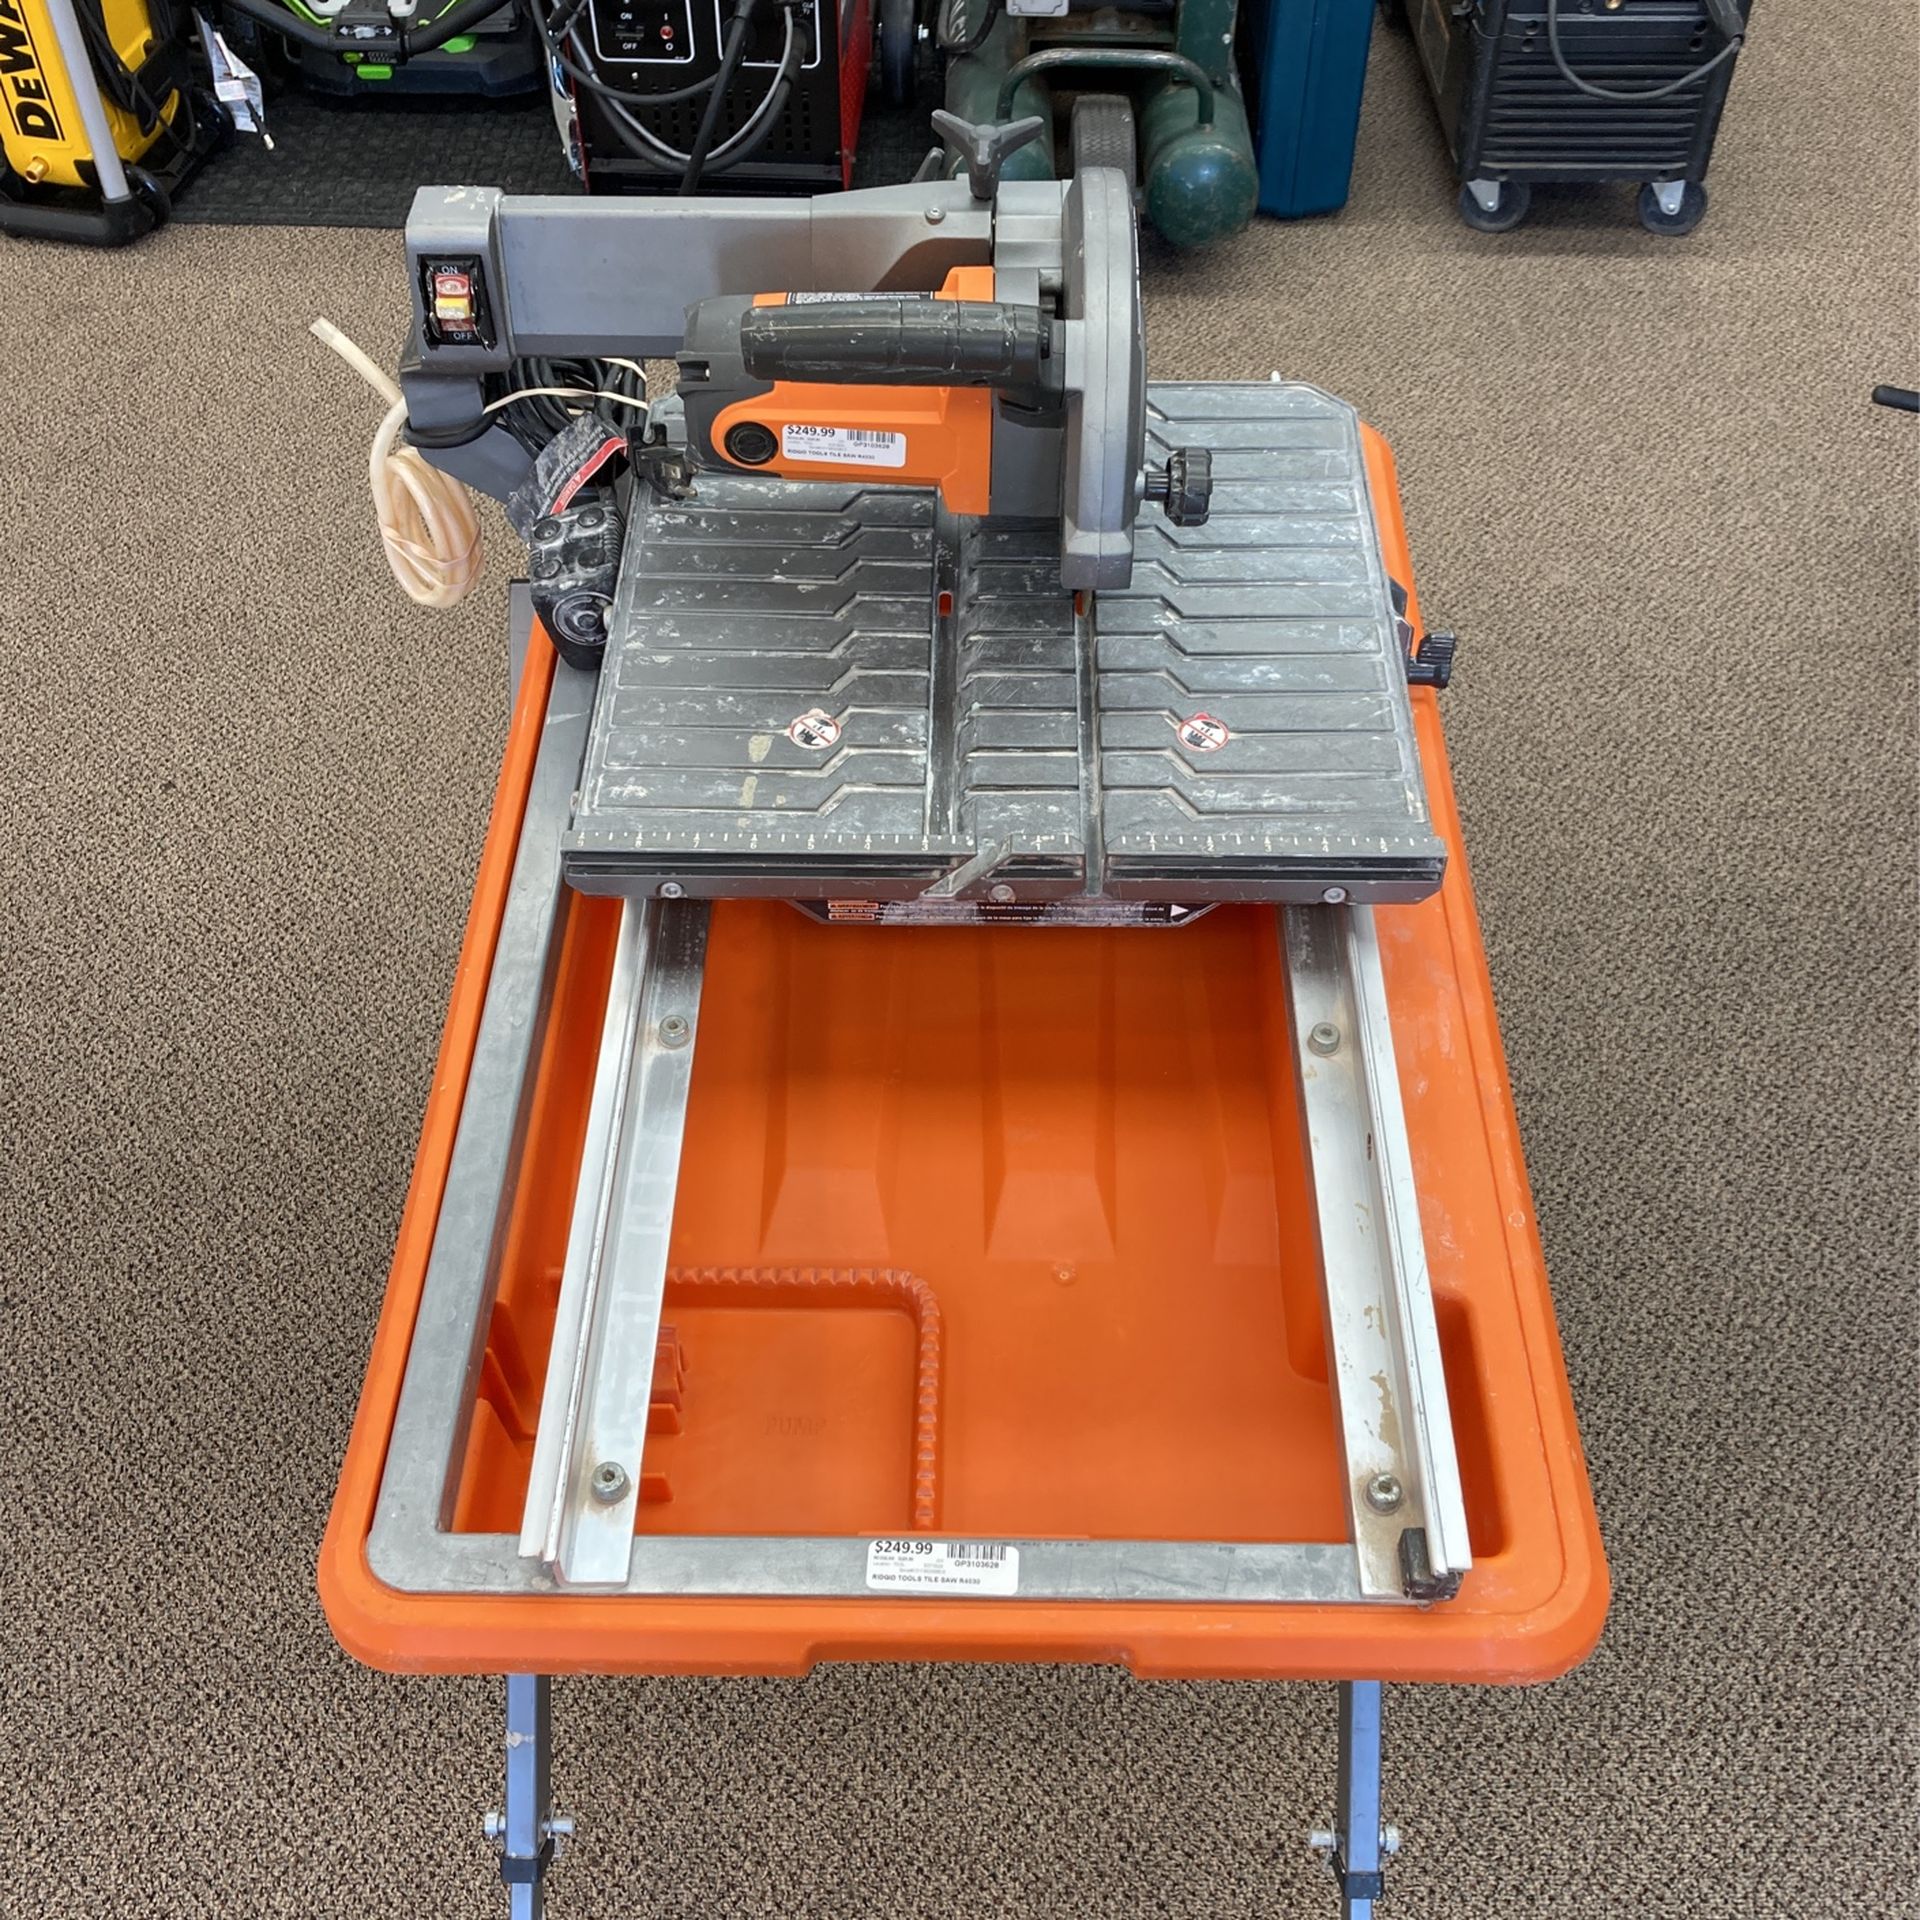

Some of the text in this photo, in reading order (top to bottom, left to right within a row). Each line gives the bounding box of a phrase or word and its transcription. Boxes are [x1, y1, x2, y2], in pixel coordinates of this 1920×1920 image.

[620, 12, 633, 20] ON
[622, 42, 637, 50] OFF
[441, 265, 458, 275] ON
[453, 332, 472, 340] OFF
[787, 425, 835, 437] $249.99
[764, 1415, 826, 1435] PUMP
[875, 1540, 933, 1555] $249.99
